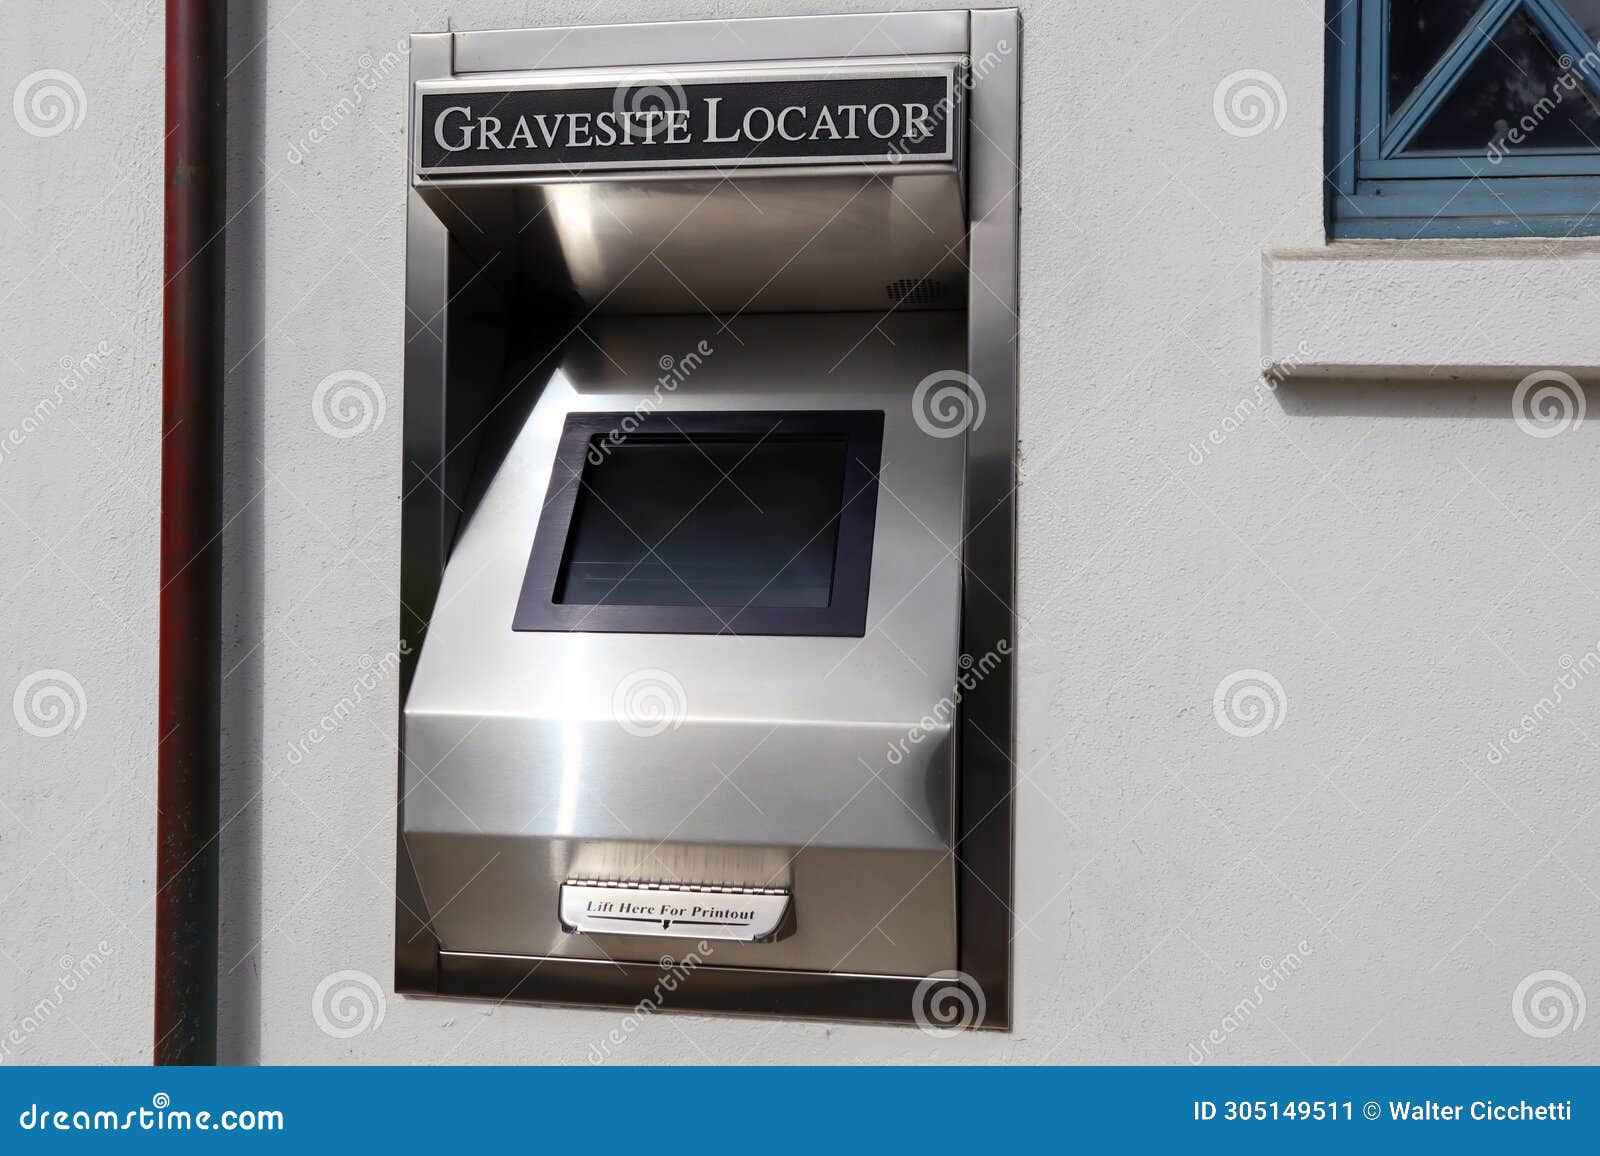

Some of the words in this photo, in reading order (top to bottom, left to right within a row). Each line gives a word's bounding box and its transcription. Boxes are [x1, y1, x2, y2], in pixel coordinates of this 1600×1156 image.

[434, 105, 692, 151] GRAVESITE
[702, 97, 934, 143] LOCATOR
[587, 900, 614, 912] Lift
[619, 902, 656, 914] Here
[660, 904, 687, 916] For
[691, 906, 755, 920] Printout
